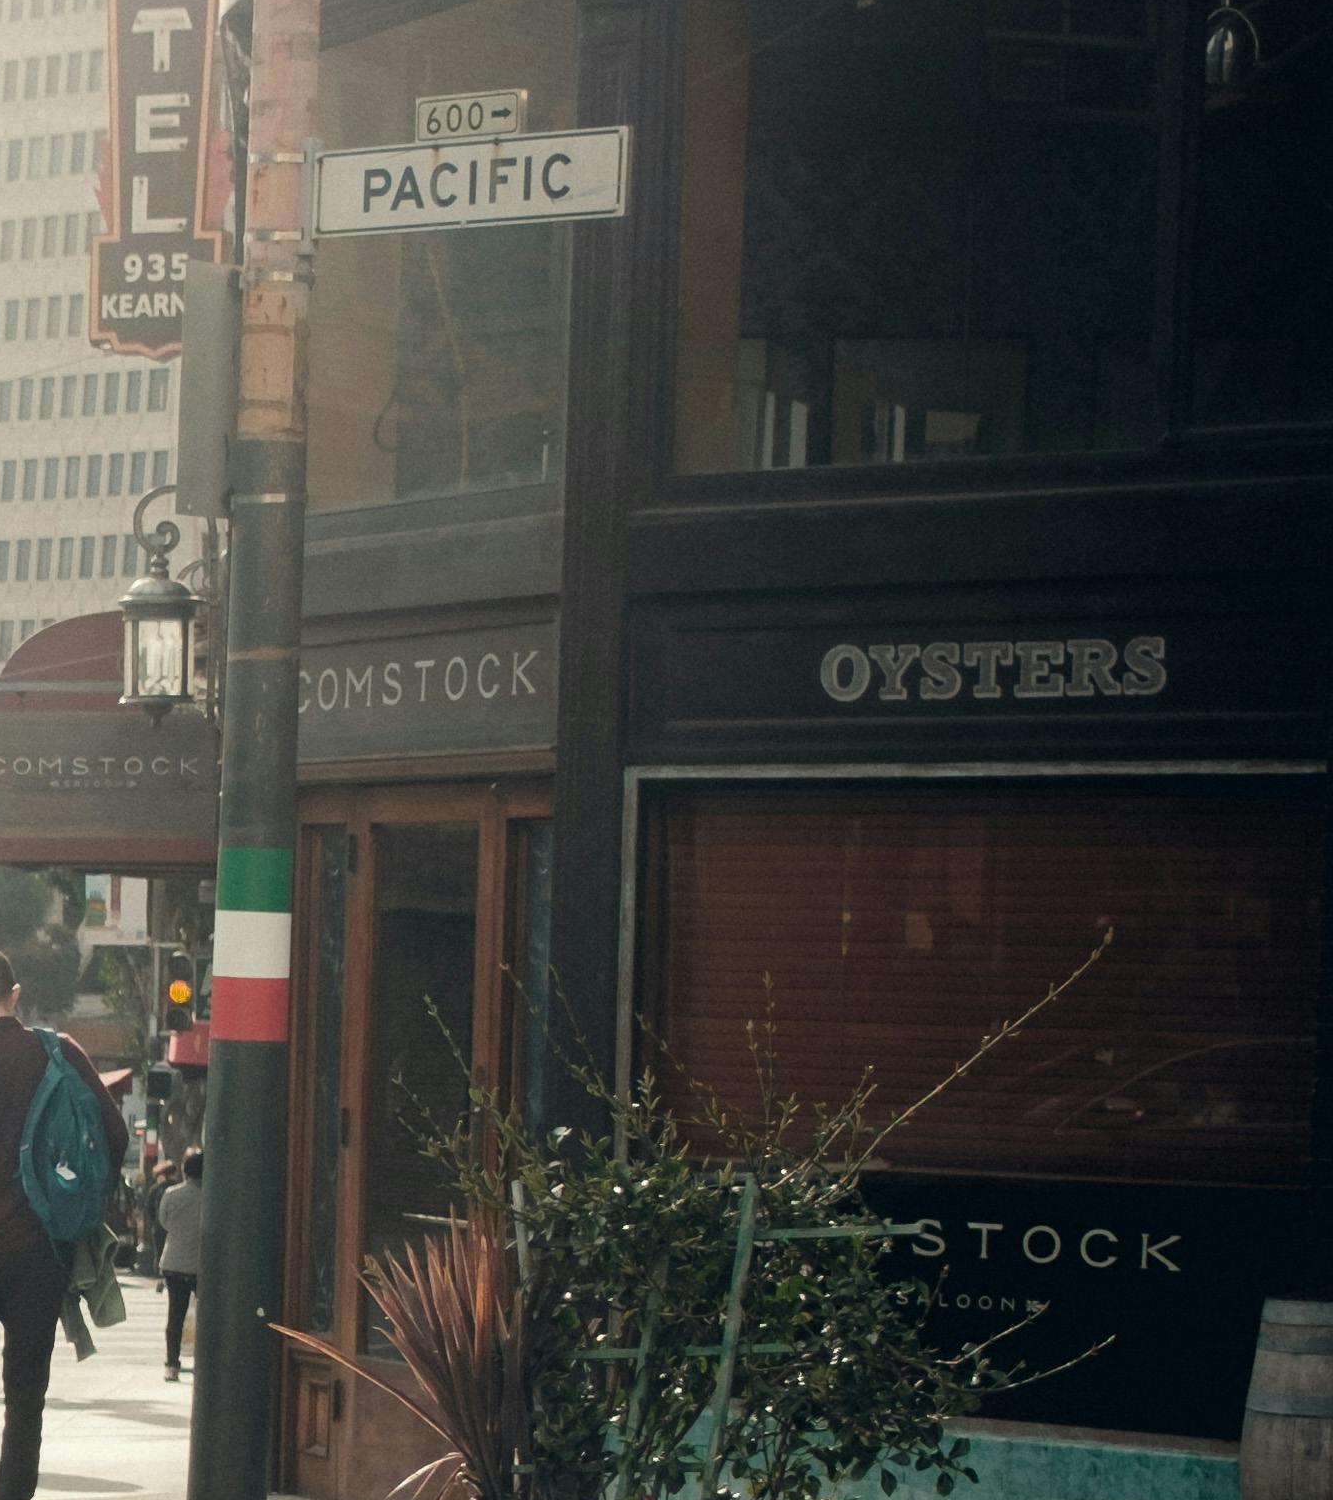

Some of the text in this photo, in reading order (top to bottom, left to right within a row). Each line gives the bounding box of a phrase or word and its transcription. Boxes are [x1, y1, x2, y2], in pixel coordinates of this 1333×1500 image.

[426, 103, 484, 136] 600
[361, 153, 573, 214] PACIFIC
[124, 252, 189, 282] 935
[101, 292, 185, 319] KEARN
[819, 635, 1168, 702] OYSTERS
[911, 1218, 1183, 1272] STOCK
